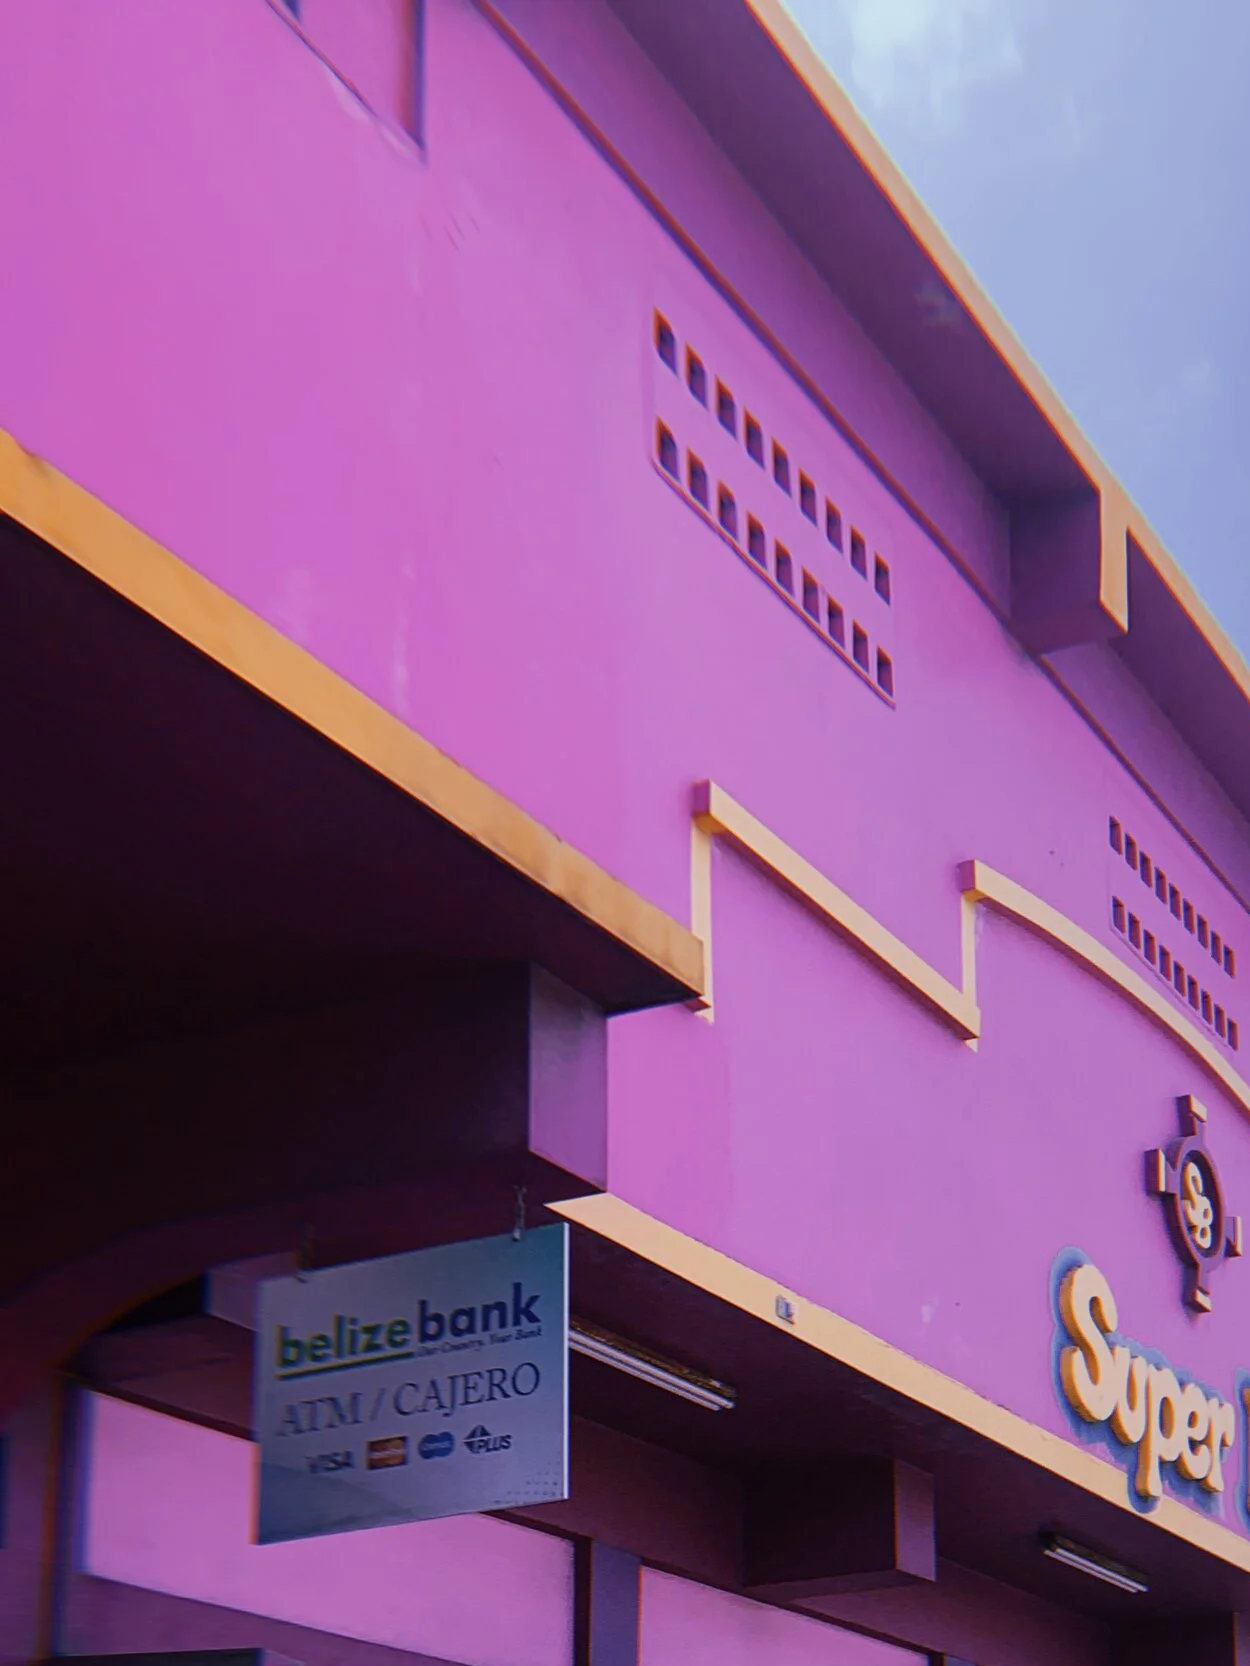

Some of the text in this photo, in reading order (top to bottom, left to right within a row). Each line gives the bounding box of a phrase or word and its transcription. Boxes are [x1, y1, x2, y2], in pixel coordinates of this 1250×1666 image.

[275, 1392, 362, 1438] ATM
[393, 1362, 541, 1418] CAJERO
[1058, 1264, 1236, 1500] Super
[305, 1450, 356, 1474] VISA
[477, 1433, 512, 1453] PLUS
